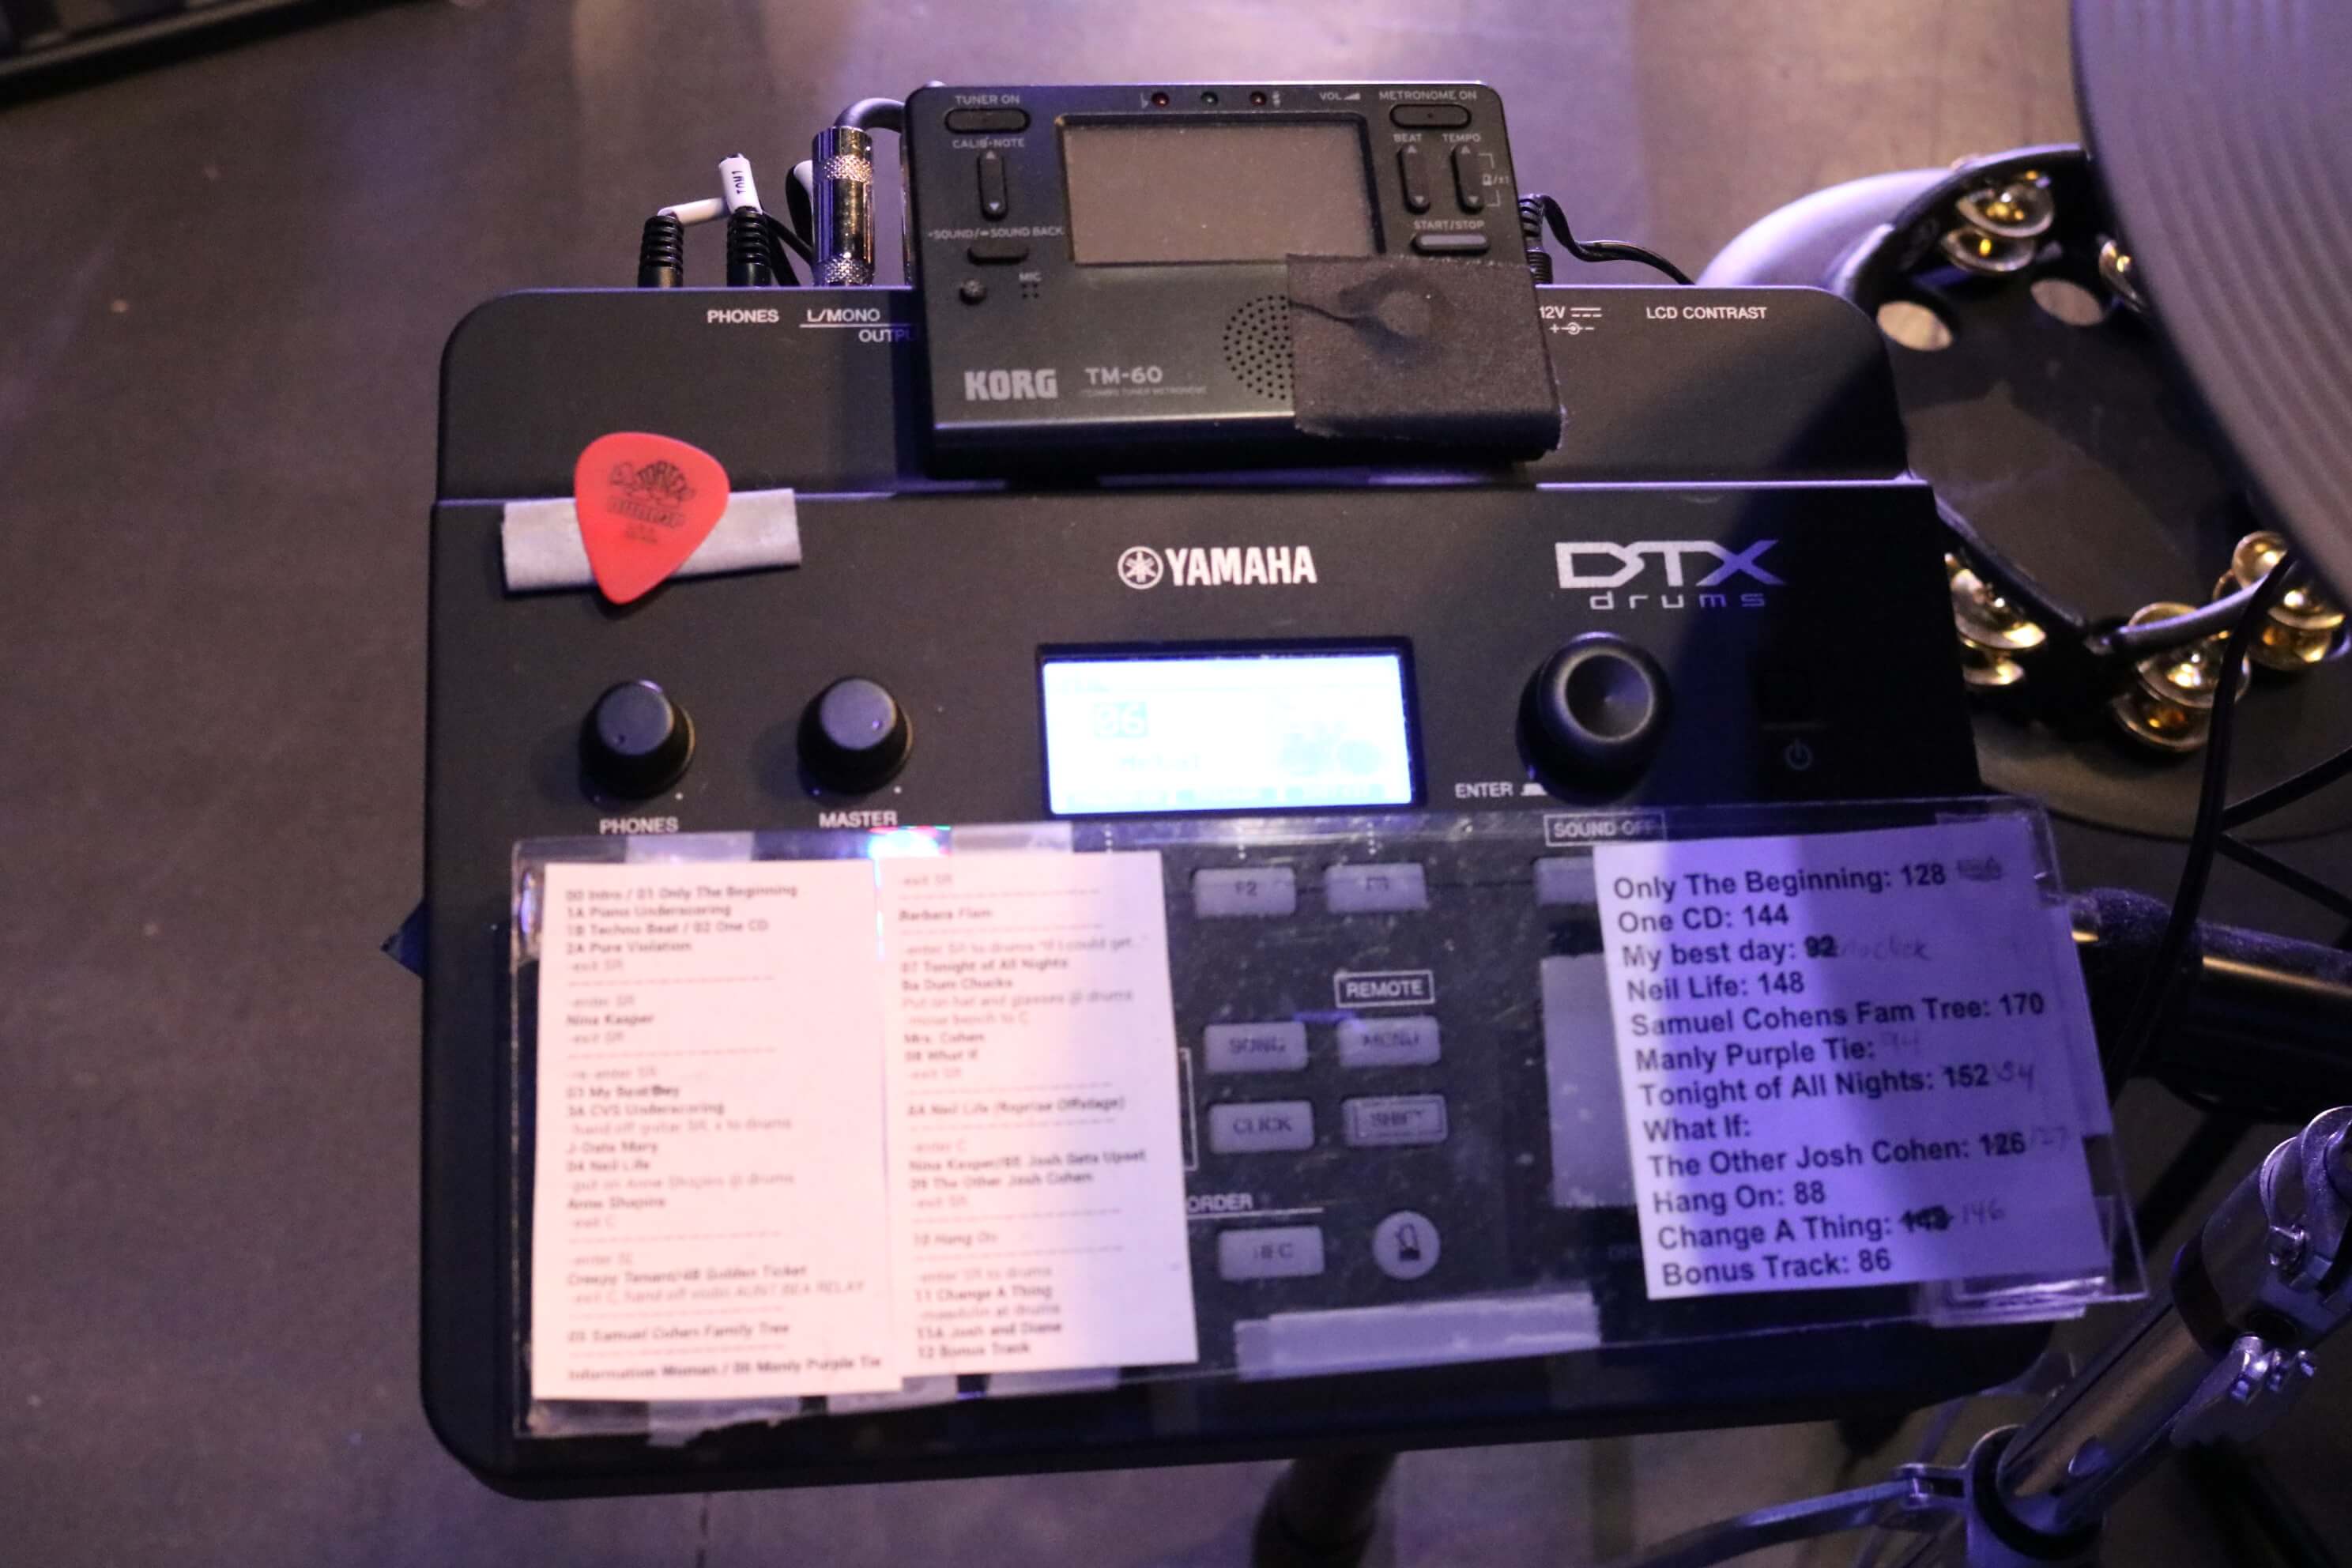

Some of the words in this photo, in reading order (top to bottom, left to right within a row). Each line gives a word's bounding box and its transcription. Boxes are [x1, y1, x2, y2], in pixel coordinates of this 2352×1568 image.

[955, 95, 998, 105] TUNER
[1001, 95, 1020, 105] ON
[1319, 92, 1342, 101] VOL
[1379, 91, 1456, 100] METRONOME
[1459, 91, 1477, 100] ON
[1393, 133, 1423, 142] BEAT
[1442, 133, 1482, 142] TEMPO
[1033, 226, 1064, 236] BACK
[1414, 220, 1485, 230] START/STOP
[1019, 272, 1041, 282] MIC
[707, 308, 779, 324] PHONES
[807, 307, 880, 322] L/MONO
[1645, 307, 1679, 319] LCD
[1683, 307, 1767, 319] CONTRAST
[964, 369, 1058, 401] KORG
[1085, 366, 1163, 385] TM-60
[1165, 545, 1317, 586] YAMAHA
[1555, 539, 1785, 589] DTX
[1589, 592, 1765, 610] drums
[1455, 782, 1513, 798] ENTER
[599, 816, 679, 835] PHONES
[819, 810, 898, 829] MASTER
[1553, 821, 1615, 839] SOUND
[1621, 819, 1657, 835] OFF
[1613, 876, 1675, 903] Only
[1683, 873, 1736, 895] The
[1745, 866, 1891, 897] Beginning:
[1901, 862, 1946, 886] 128
[659, 886, 692, 902] Only
[696, 885, 721, 898] The
[726, 884, 798, 899] Beginning
[1618, 911, 1674, 933] One
[1682, 906, 1733, 929] CD:
[1743, 903, 1789, 927] 144
[1622, 944, 1660, 972] My
[1670, 940, 1731, 965] best
[1739, 937, 1796, 966] day:
[1346, 978, 1423, 1000] REMOTE
[1627, 975, 1679, 1001] Neil
[1688, 973, 1749, 999] Life:
[1758, 971, 1806, 994] 148
[1631, 1008, 1733, 1037] Samuel
[1743, 1005, 1849, 1031] Cohens
[1855, 1001, 1915, 1025] Fam
[1922, 996, 1990, 1020] Tree:
[1998, 991, 2045, 1016] 170
[1634, 1045, 1717, 1074] Manly
[1725, 1040, 1816, 1070] Purple
[1822, 1035, 1875, 1060] Tie:
[1638, 1079, 1747, 1110] Tonight
[1755, 1076, 1781, 1099] of
[1791, 1072, 1827, 1098] All
[1835, 1068, 1934, 1099] Nights:
[1944, 1063, 1991, 1087] 152
[1231, 1115, 1293, 1136] CLICK
[1643, 1114, 1718, 1143] What
[1724, 1113, 1751, 1138] If:
[1648, 1153, 1701, 1178] The
[1709, 1148, 1787, 1175] Other
[1796, 1143, 1864, 1169] Josh
[1871, 1136, 1969, 1164] Cohen:
[1980, 1130, 2026, 1156] 126
[1653, 1190, 1728, 1217] Hang
[1735, 1183, 1785, 1208] On:
[1794, 1181, 1826, 1205] 88
[1657, 1223, 1766, 1252] Change
[1775, 1218, 1796, 1243] A
[1801, 1213, 1894, 1243] Thing:
[1661, 1261, 1755, 1287] Bonus
[1762, 1252, 1850, 1280] Track:
[1858, 1246, 1893, 1274] 86
